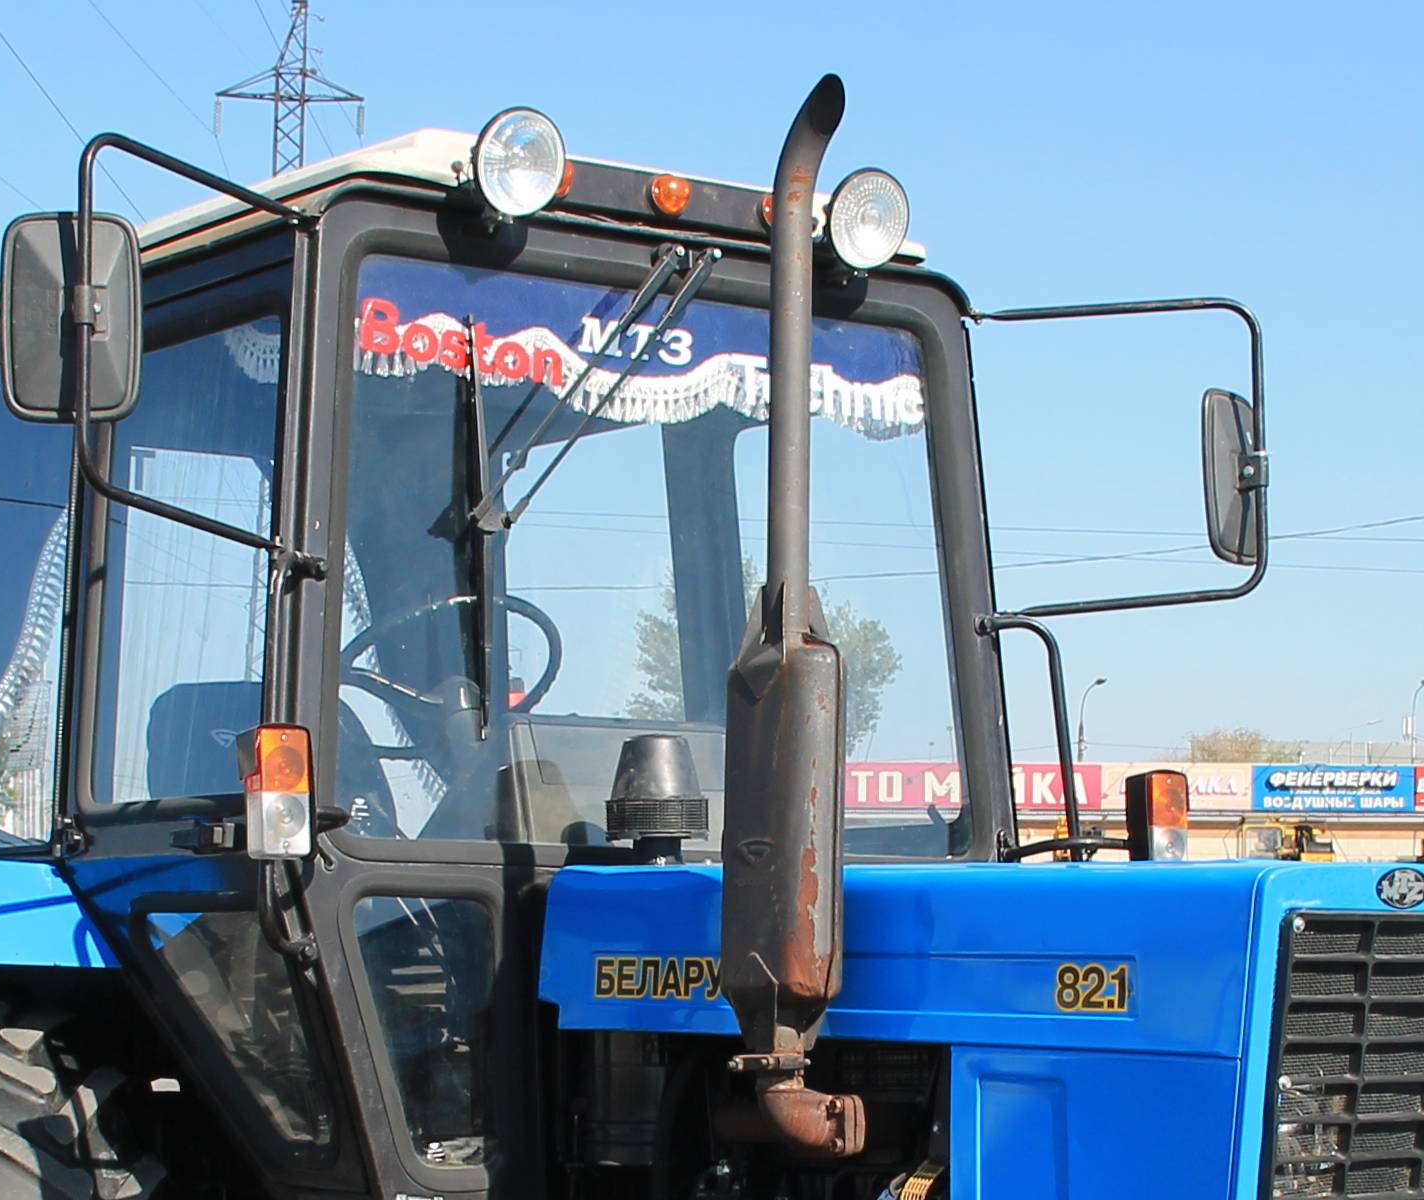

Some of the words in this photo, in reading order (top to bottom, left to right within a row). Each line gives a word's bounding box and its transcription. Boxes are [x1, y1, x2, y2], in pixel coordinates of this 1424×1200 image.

[361, 298, 565, 386] Boston
[1360, 796, 1405, 809] ШАРЫ
[594, 954, 723, 1000] БЕЛАРУ
[1055, 963, 1129, 1013] 82.1
